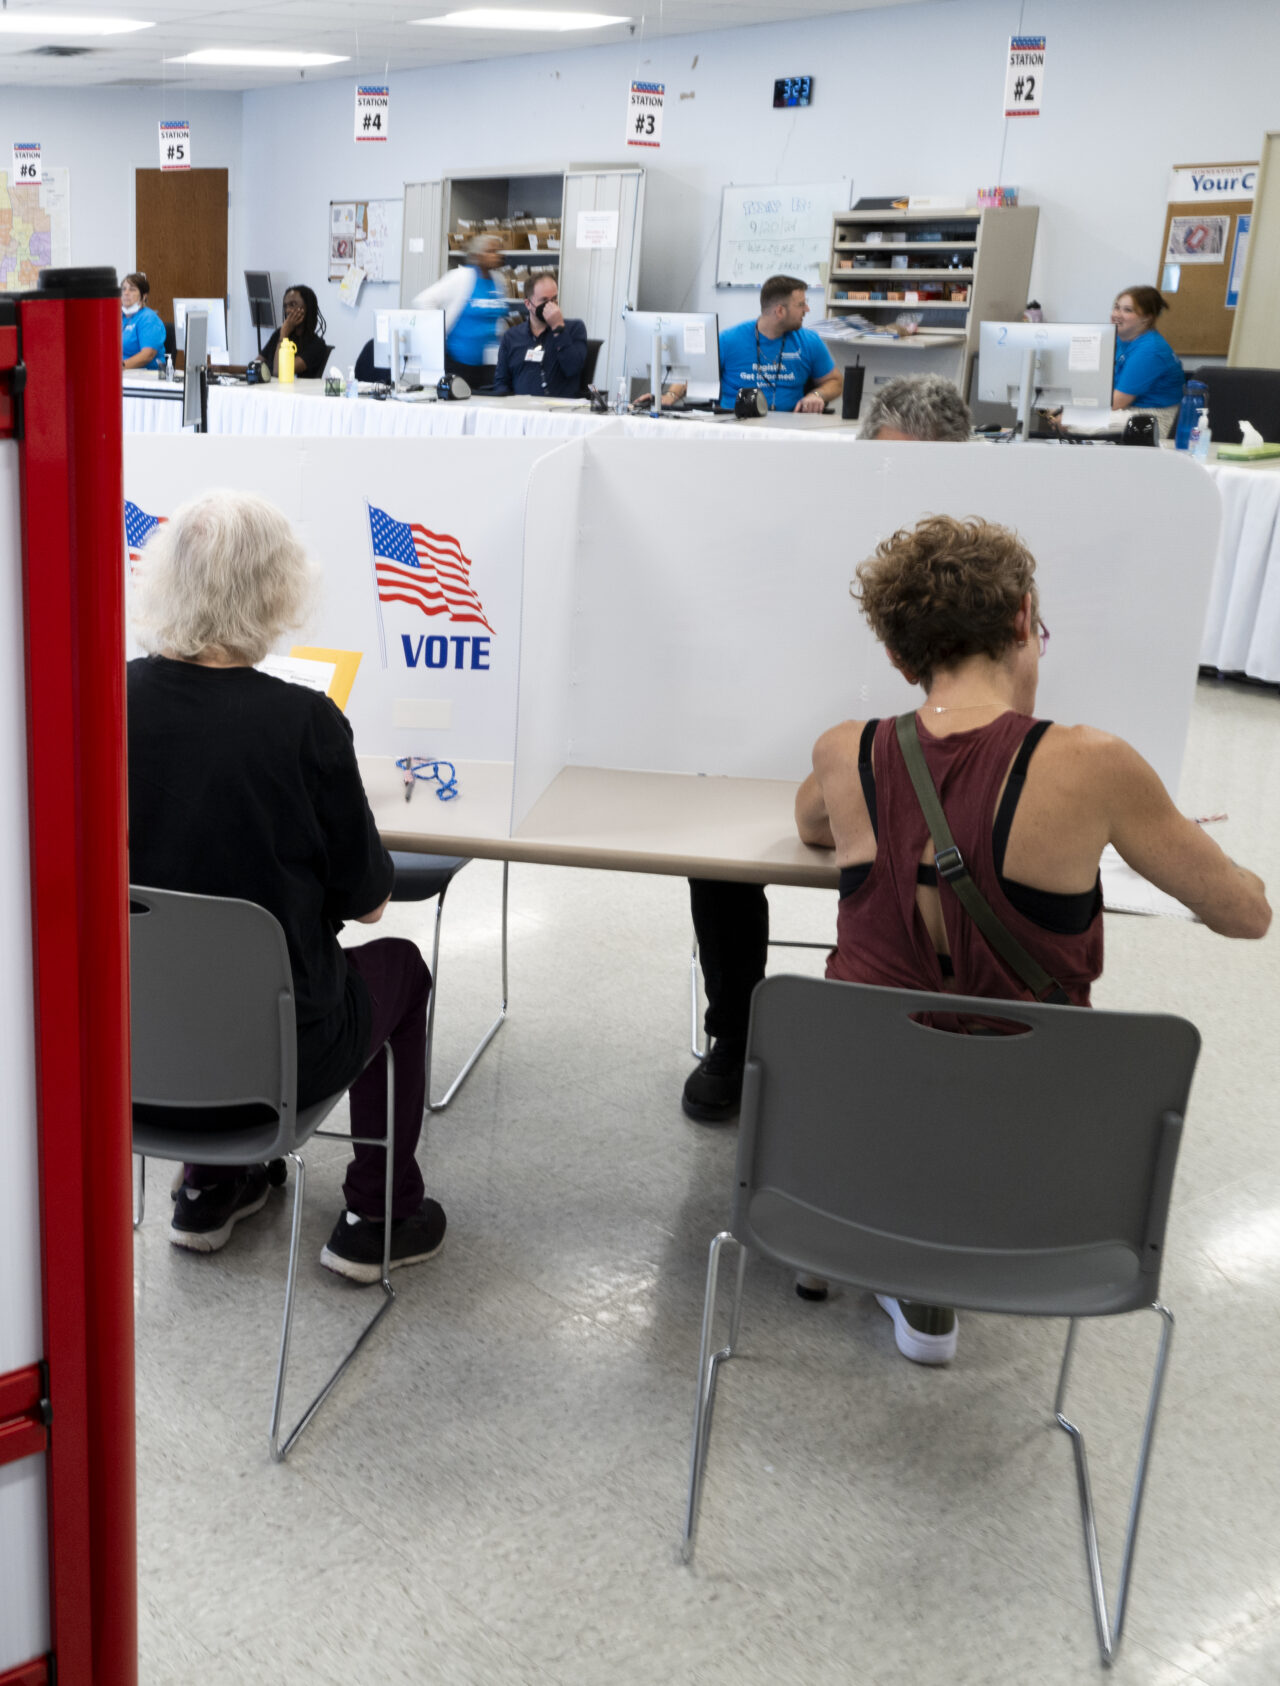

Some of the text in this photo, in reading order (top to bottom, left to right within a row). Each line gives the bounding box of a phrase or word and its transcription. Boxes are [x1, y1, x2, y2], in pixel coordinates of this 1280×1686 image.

[1010, 53, 1044, 66] STATION
[1014, 75, 1035, 101] #2
[358, 97, 388, 106] STATION
[631, 94, 663, 107] STATION
[363, 113, 382, 131] #4
[635, 113, 655, 135] #3
[161, 131, 189, 139] STATION
[15, 151, 40, 159] STATION
[167, 144, 184, 160] #5
[20, 163, 36, 177] #6
[1192, 174, 1238, 191] Your
[997, 326, 1008, 345] 2
[740, 371, 755, 381] Get
[401, 634, 490, 670] VOTE
